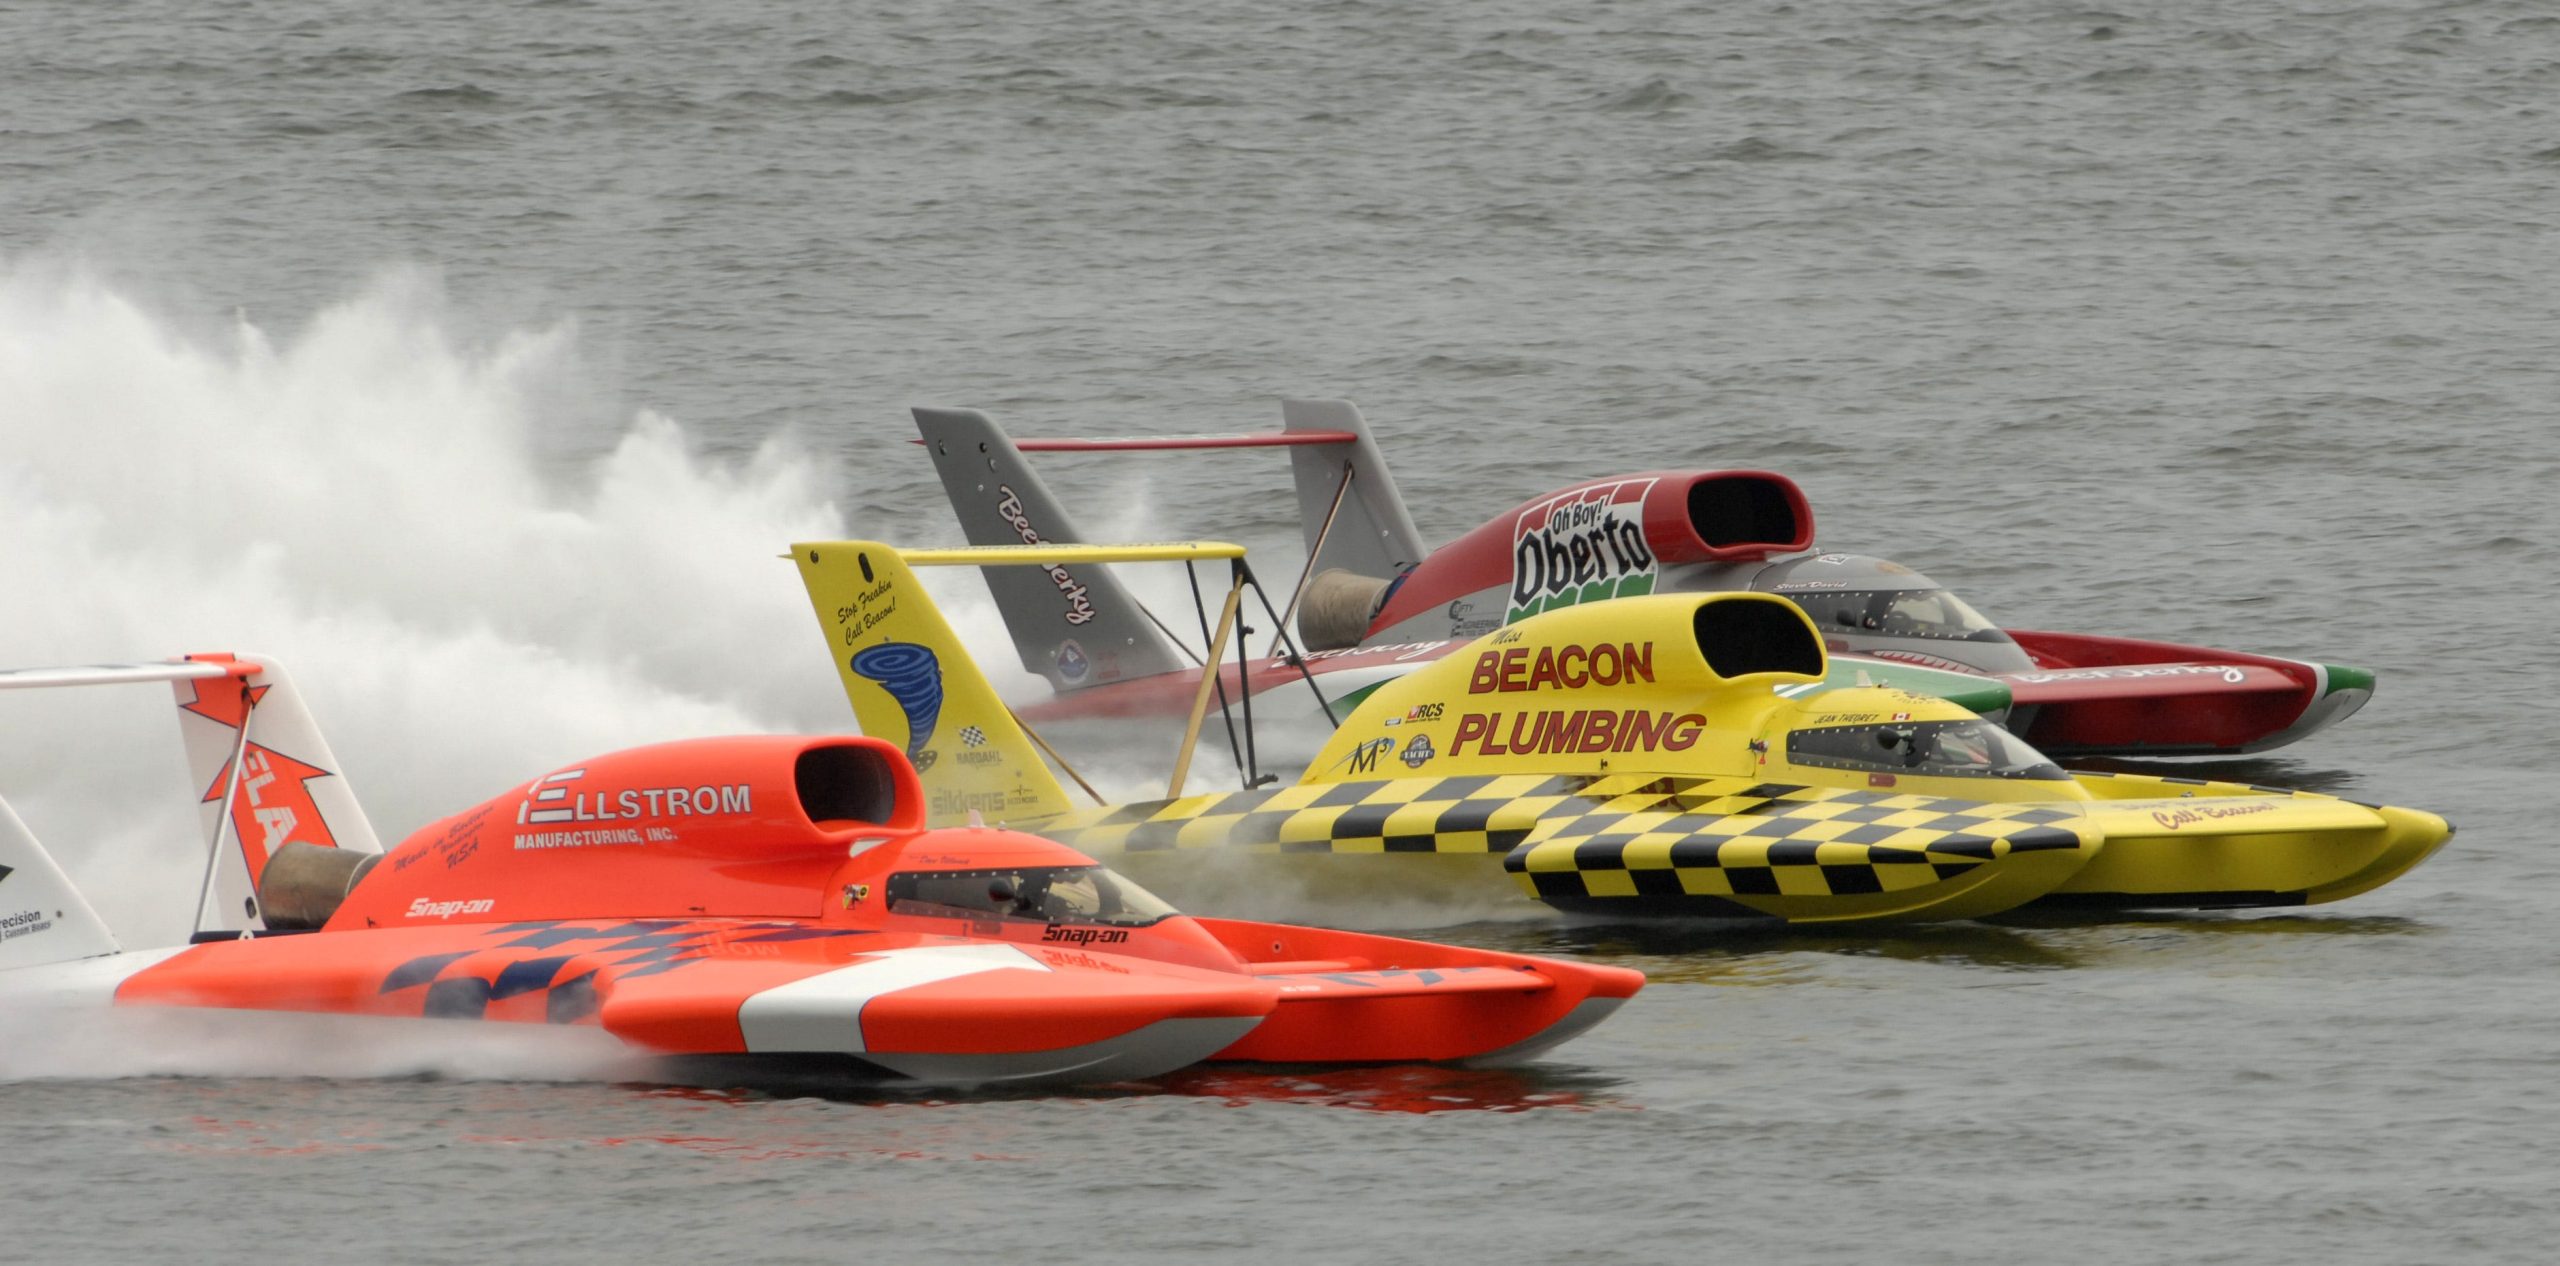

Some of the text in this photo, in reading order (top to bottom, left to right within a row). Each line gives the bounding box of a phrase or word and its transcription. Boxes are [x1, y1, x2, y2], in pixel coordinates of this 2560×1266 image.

[1552, 499, 1604, 535] Oh Boy!
[1513, 511, 1652, 608] Oberto
[837, 602, 858, 625] Stop
[845, 595, 897, 647] Call Beacon!
[1490, 628, 1524, 646] Miss
[1468, 641, 1657, 695] BEACON
[1416, 702, 1446, 719] RCS
[1814, 714, 1836, 725] JEAN
[1448, 709, 1708, 757] PLUMBING
[516, 768, 752, 825] ELLSTROM
[514, 826, 678, 850] MANUFACTURING, INC.
[404, 897, 496, 920] Snap-on
[1041, 923, 1130, 948] Snap-on
